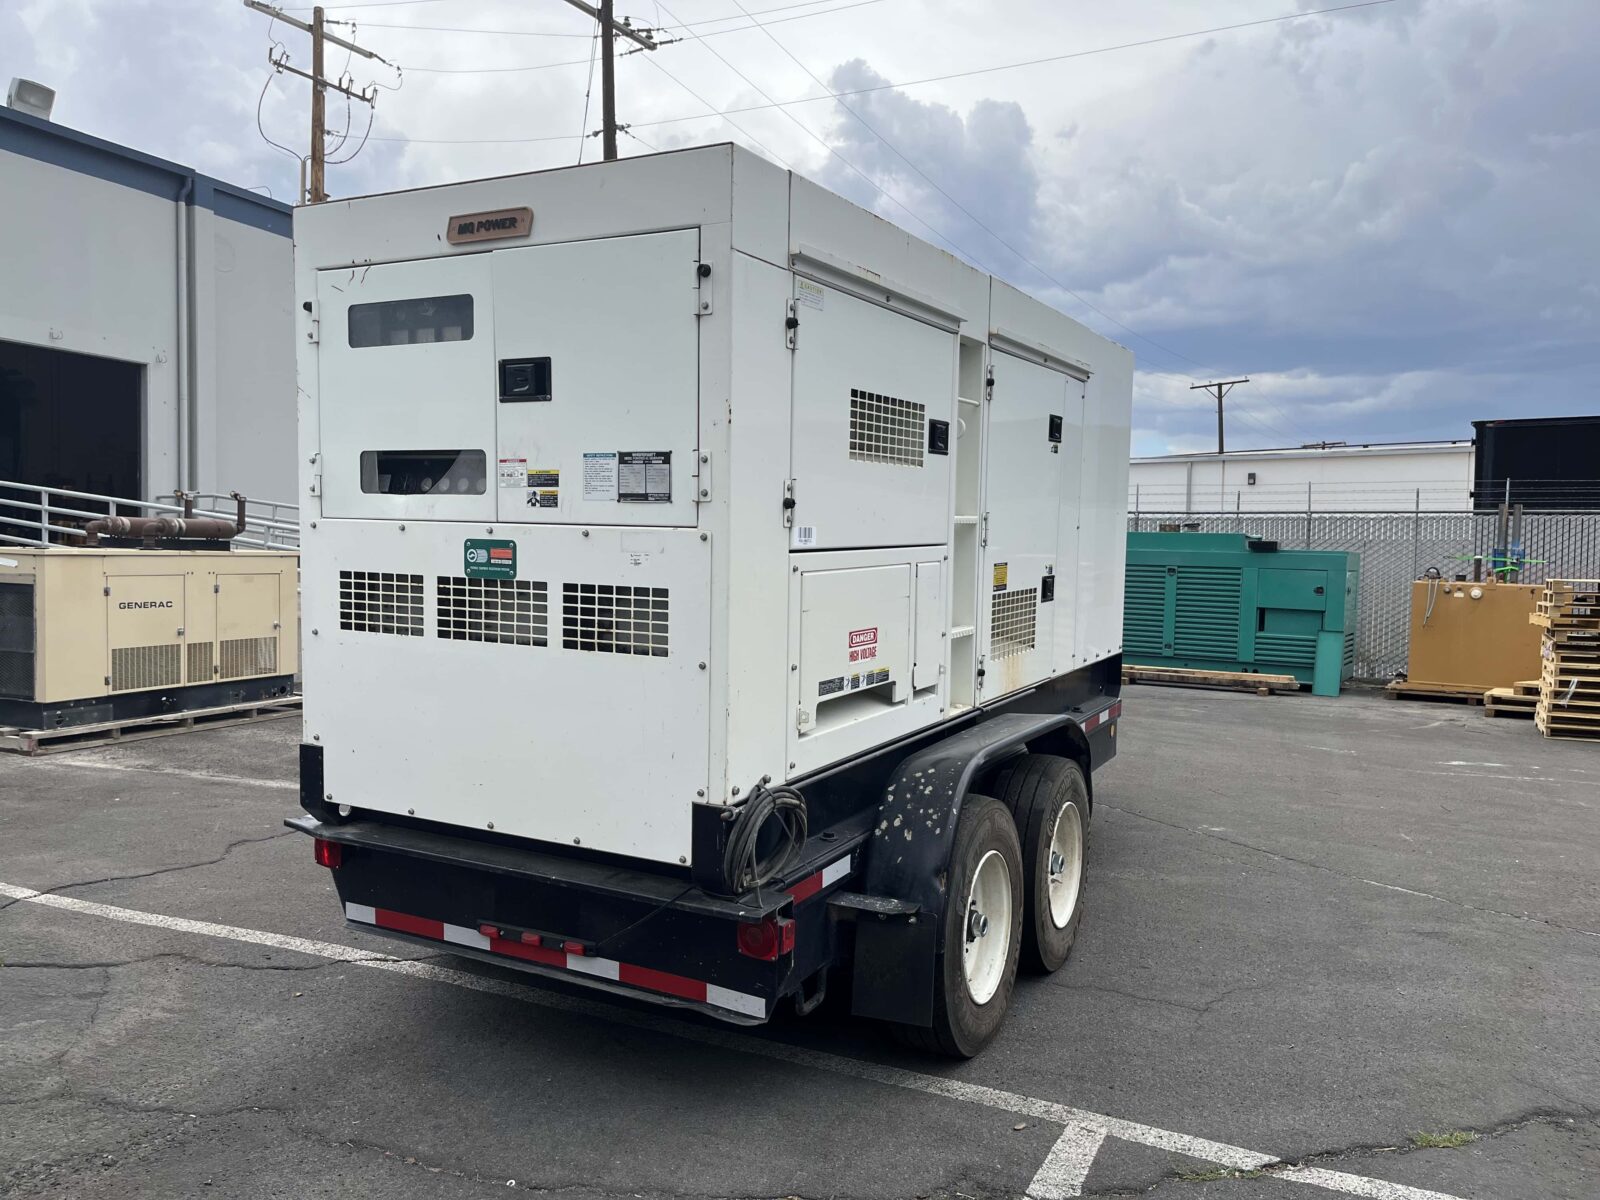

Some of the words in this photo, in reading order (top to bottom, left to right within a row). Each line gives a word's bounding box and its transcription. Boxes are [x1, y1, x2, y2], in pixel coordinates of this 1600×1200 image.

[458, 221, 475, 235] MQ
[476, 216, 518, 233] POWER
[118, 600, 173, 610] GENERAC
[852, 631, 875, 644] DANGER
[860, 646, 877, 660] VOLTAGE
